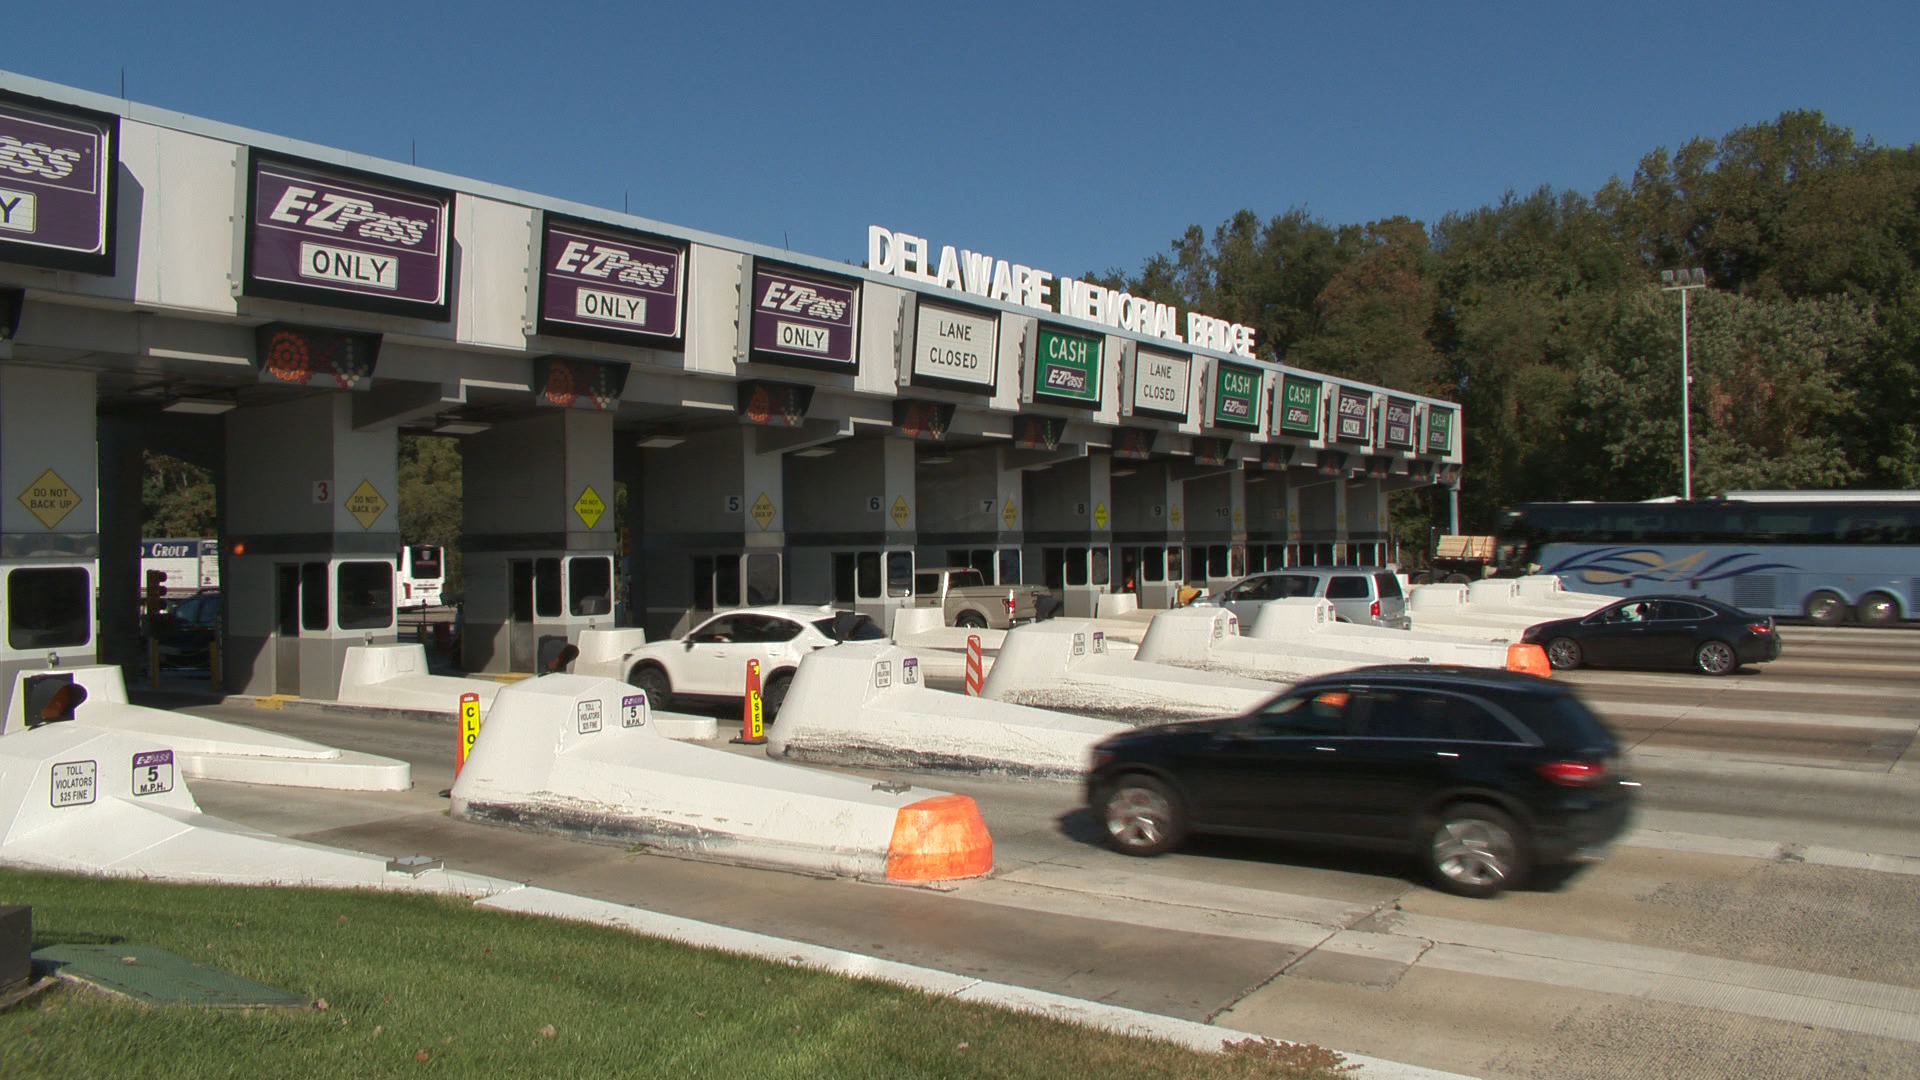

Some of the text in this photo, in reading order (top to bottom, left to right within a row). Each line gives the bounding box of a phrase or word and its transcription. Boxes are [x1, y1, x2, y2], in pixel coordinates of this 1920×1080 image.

[270, 186, 428, 245] E-ZPass
[313, 250, 388, 282] ONLY
[556, 240, 668, 288] E-ZPass
[868, 225, 1256, 359] DELAWARE MEMORIAL BRIDGE
[585, 294, 640, 320] ONLY
[761, 282, 846, 320] E-ZPass
[784, 326, 824, 348] ONLY
[940, 321, 972, 342] LANE
[1050, 336, 1087, 364] CASH
[930, 347, 978, 370] CLOSED
[1150, 362, 1172, 380] LANE
[1224, 372, 1250, 394] CASH
[1144, 384, 1176, 401] CLOSED
[1288, 385, 1311, 404] CASH
[1344, 420, 1359, 432] ONLY
[34, 488, 68, 498] DO NOT
[318, 482, 328, 501] 3
[30, 500, 72, 508] BACK UP
[354, 496, 363, 504] DO
[729, 496, 739, 512] 5
[870, 496, 880, 510] 6
[984, 500, 992, 512] 7
[1078, 503, 1085, 514] 8
[1154, 506, 1161, 516] 9
[1216, 507, 1229, 516] 10
[909, 666, 913, 676] 5
[585, 704, 594, 712] TOLL
[630, 706, 636, 718] 5
[136, 752, 170, 765] E-ZPASS
[66, 766, 83, 776] TOLL
[148, 766, 158, 782] 5
[56, 776, 92, 790] VIOLATORS
[140, 782, 166, 793] M.P.H.
[60, 790, 88, 802] $25 FINE
